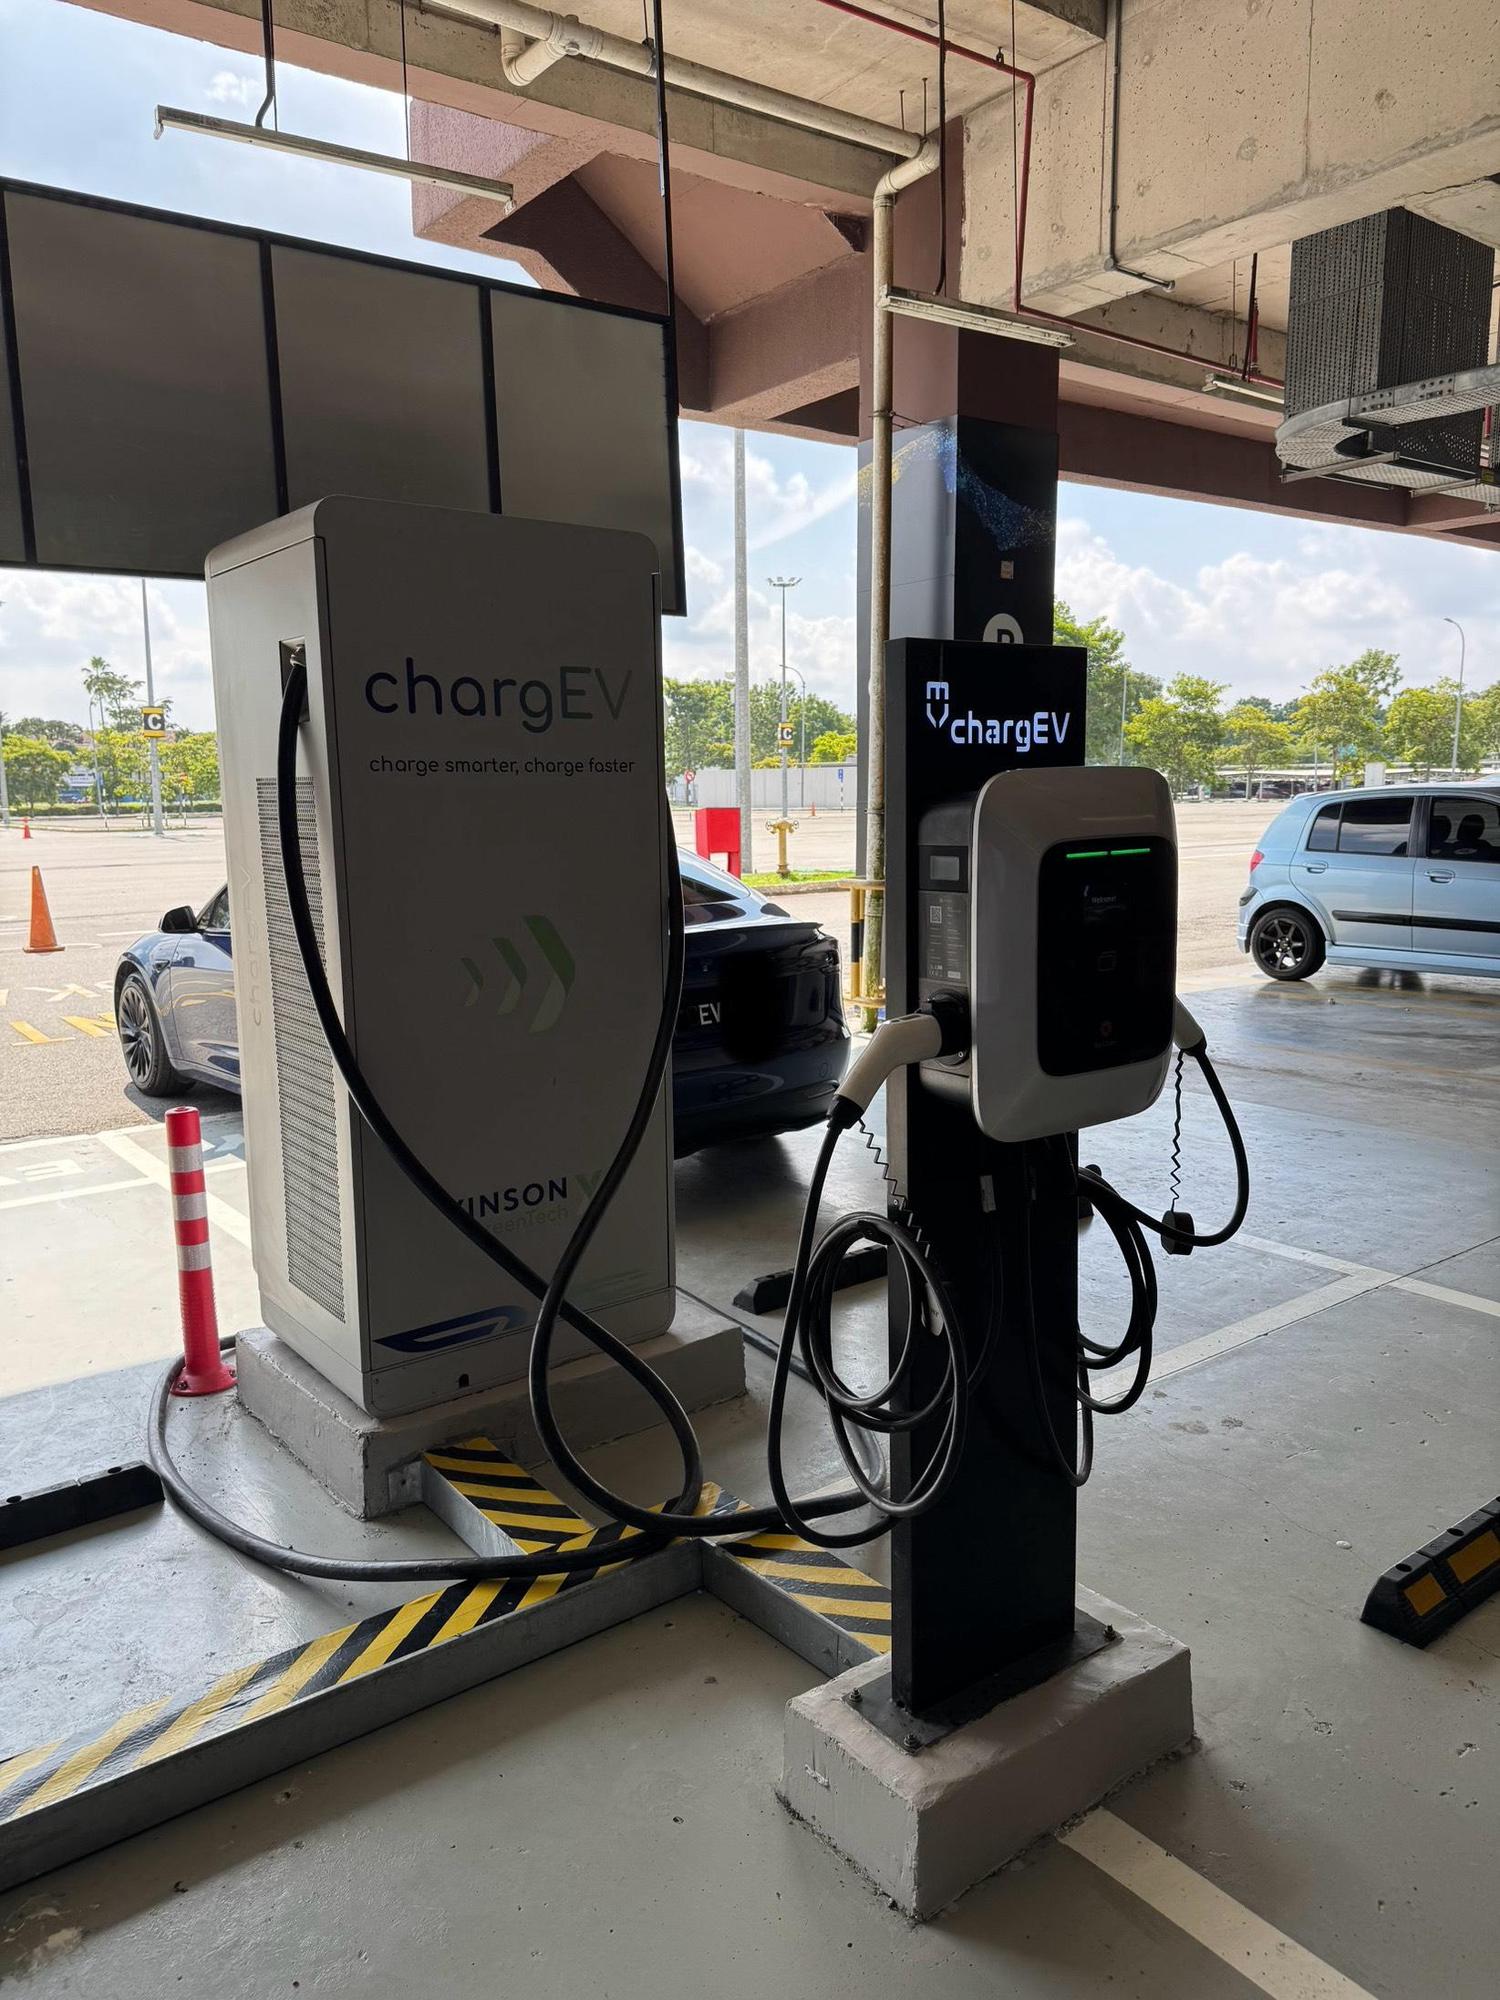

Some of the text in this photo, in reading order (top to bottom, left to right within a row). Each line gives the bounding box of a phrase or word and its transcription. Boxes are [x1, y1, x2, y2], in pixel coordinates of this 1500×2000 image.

[365, 657, 632, 733] chargEV
[147, 714, 162, 730] C
[950, 710, 1071, 752] chargEV
[783, 727, 793, 740] C
[369, 756, 635, 776] charge smarter, charge faster
